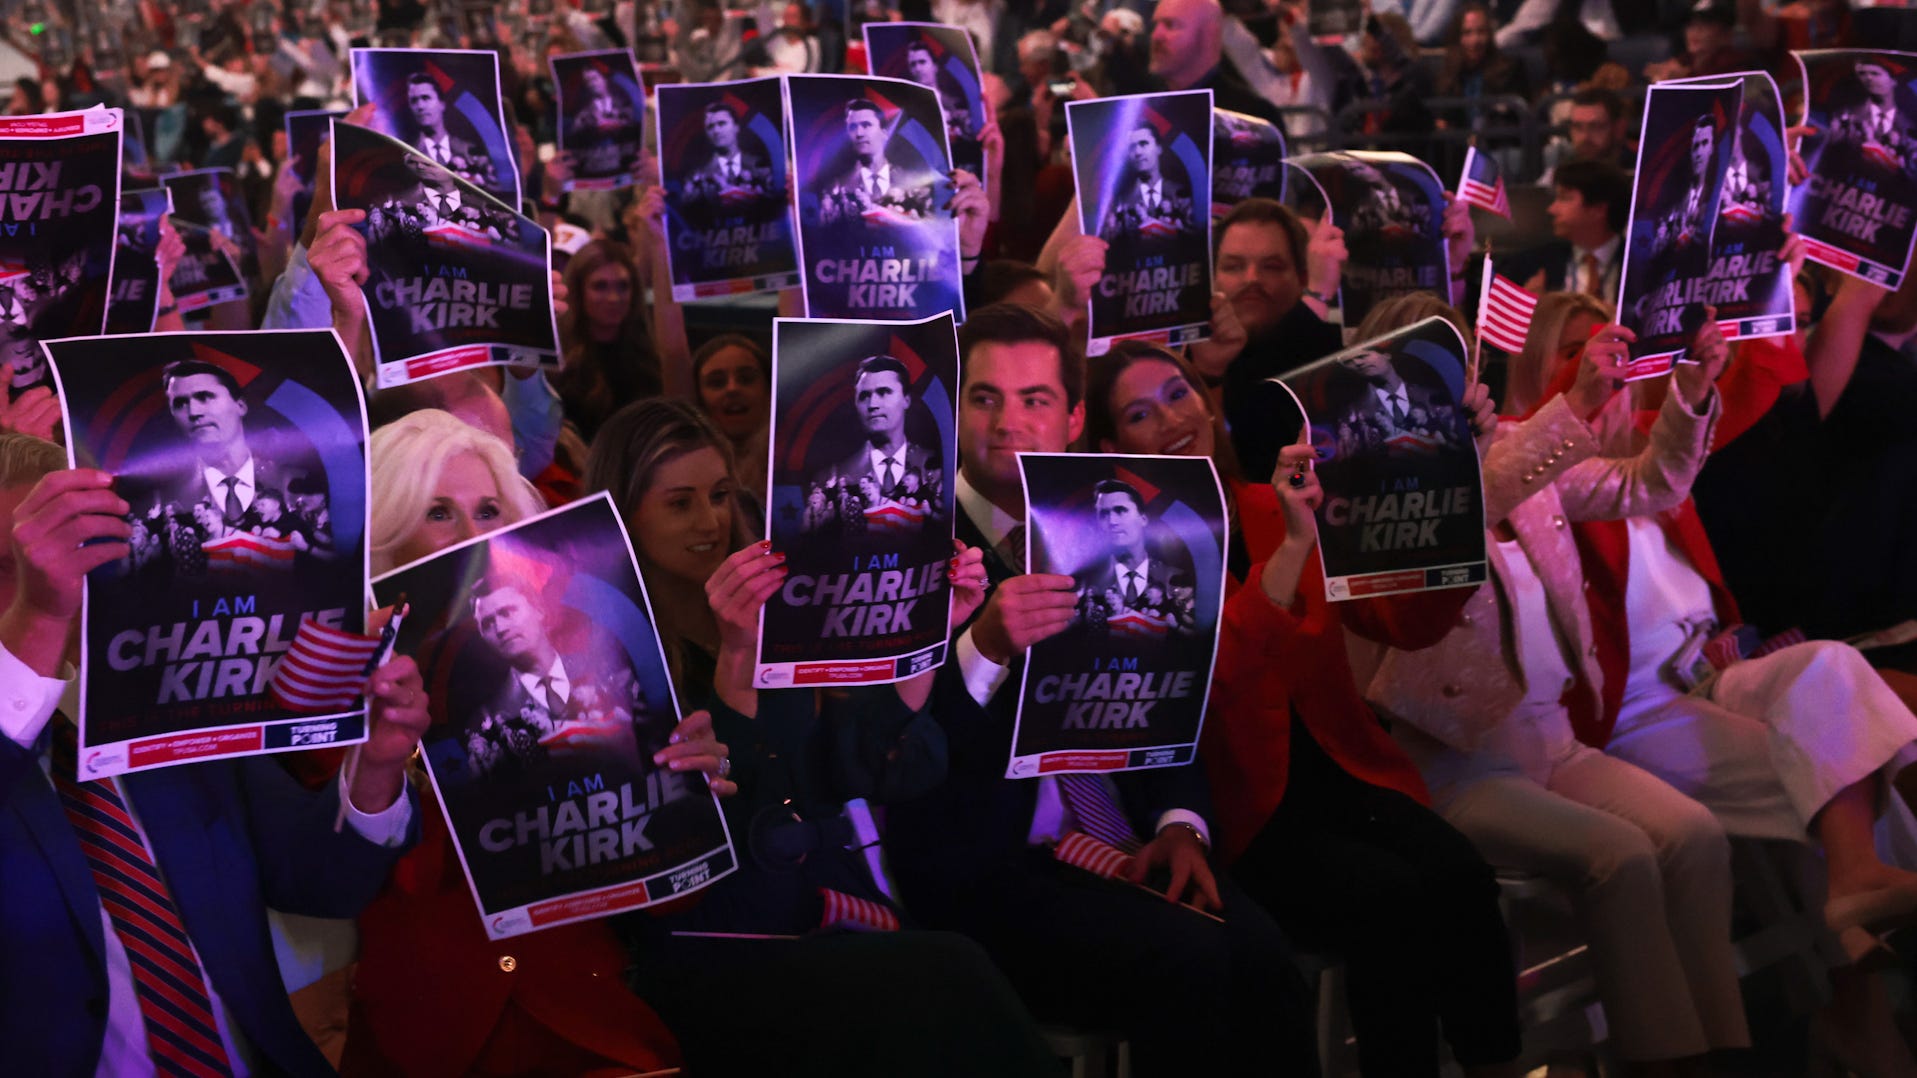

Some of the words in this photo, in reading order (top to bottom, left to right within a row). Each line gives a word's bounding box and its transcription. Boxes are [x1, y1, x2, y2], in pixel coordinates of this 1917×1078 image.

[677, 222, 780, 250] CHARLIE
[1822, 202, 1882, 244] KIRK
[703, 246, 760, 269] KIRK
[860, 246, 866, 258] I
[871, 246, 895, 257] AM
[1145, 256, 1164, 269] AM
[424, 264, 430, 276] I
[439, 264, 468, 279] AM
[815, 257, 946, 283] CHARLIE
[1100, 261, 1201, 298] CHARLIE
[375, 277, 533, 310] CHARLIE
[848, 284, 919, 308] KIRK
[1124, 290, 1182, 318] KIRK
[411, 301, 500, 334] KIRK
[1381, 480, 1387, 493] I
[1393, 477, 1420, 493] AM
[1325, 486, 1471, 527] CHARLIE
[1361, 518, 1442, 552] KIRK
[853, 555, 860, 572] I
[867, 552, 899, 570] AM
[782, 559, 946, 607] CHARLIE
[192, 600, 199, 619] I
[211, 595, 256, 617] AM
[821, 599, 919, 639] KIRK
[1094, 657, 1101, 671] I
[1107, 656, 1139, 671] AM
[1035, 671, 1197, 704] CHARLIE
[1062, 700, 1159, 729] KIRK
[290, 730, 337, 746] POINT
[547, 785, 556, 801] I
[567, 772, 605, 798] AM
[479, 770, 688, 852] CHARLIE
[539, 813, 655, 876] KIRK
[671, 872, 712, 890] POINT
